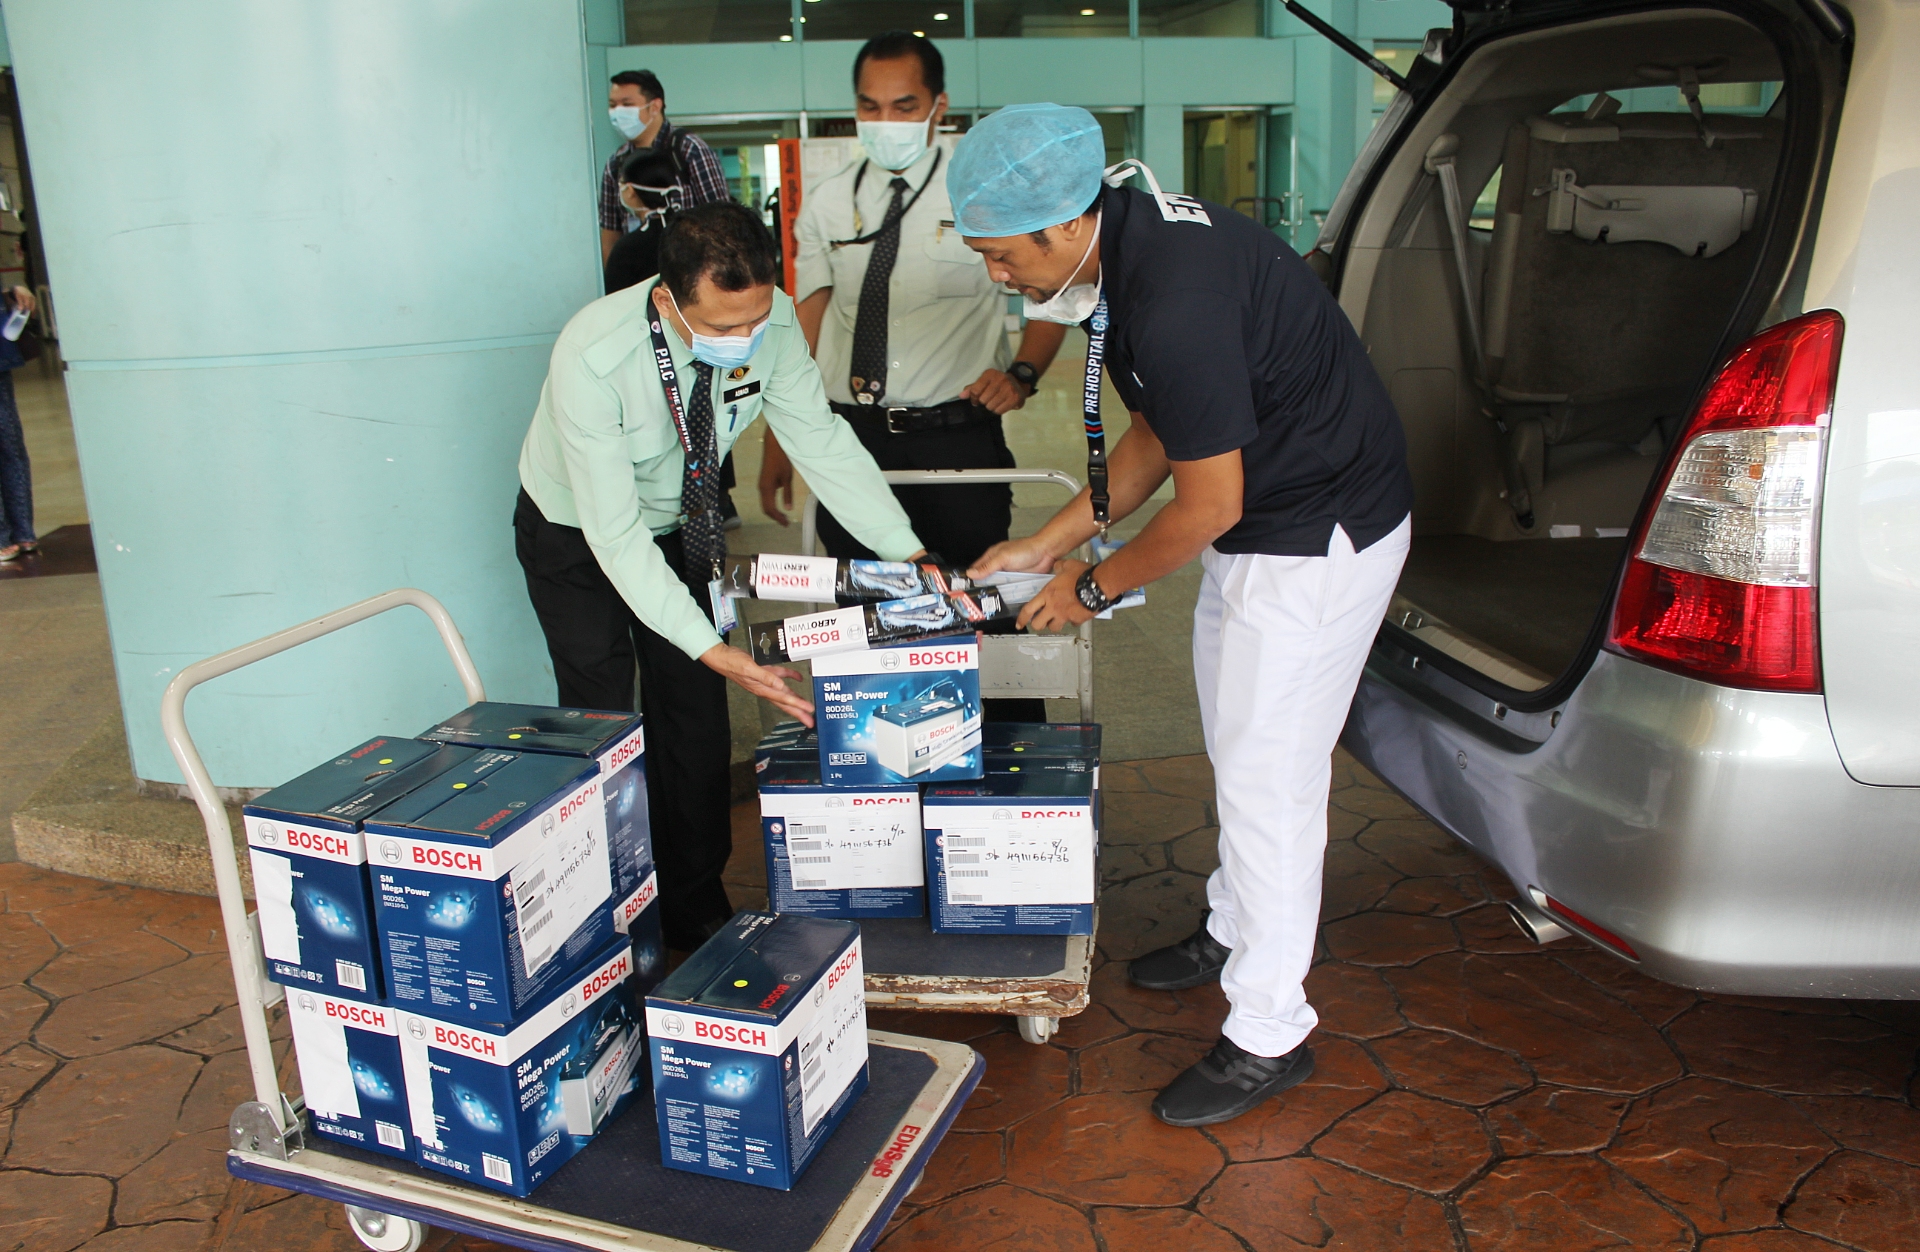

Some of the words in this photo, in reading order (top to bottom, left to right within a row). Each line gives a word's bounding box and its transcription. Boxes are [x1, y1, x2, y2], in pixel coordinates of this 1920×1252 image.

[655, 347, 675, 381] P.H.C
[1085, 333, 1105, 414] PREHOSPITAL
[670, 386, 680, 407] THE
[676, 406, 693, 452] FRONTIER
[761, 561, 810, 571] AEROTWIN
[761, 574, 809, 588] BOSCH
[788, 617, 838, 633] AEROTWIN
[790, 630, 840, 649] BOSCH
[908, 650, 969, 666] BOSCH
[823, 682, 841, 692] SM
[825, 691, 853, 703] Mega
[855, 690, 889, 701] Power
[825, 705, 855, 713] 80D26L
[929, 724, 955, 739] BOSCH
[611, 734, 642, 769] BOSCH
[606, 789, 619, 803] Power
[286, 829, 349, 857] BOSCH
[411, 846, 483, 872] BOSCH
[290, 869, 305, 879] wer
[380, 874, 394, 884] SM
[381, 883, 404, 896] Mega
[404, 886, 431, 898] Power
[625, 881, 654, 920] BOSCH
[828, 946, 858, 991] BOSCH
[583, 957, 627, 1001] BOSCH
[758, 983, 790, 1010] BOSCH
[325, 1001, 386, 1028] BOSCH
[434, 1026, 496, 1057] BOSCH
[694, 1021, 767, 1047] BOSCH
[660, 1045, 675, 1055] SM
[429, 1061, 451, 1074] Power
[517, 1059, 533, 1078] SM
[518, 1066, 543, 1091] Mega
[543, 1044, 571, 1071] Power
[603, 1048, 622, 1077] BOSCH
[661, 1054, 685, 1067] Mega
[685, 1057, 712, 1069] Power
[662, 1064, 686, 1074] 80D26L
[520, 1081, 546, 1104] 80D26L
[745, 1144, 765, 1153] BOSCH
